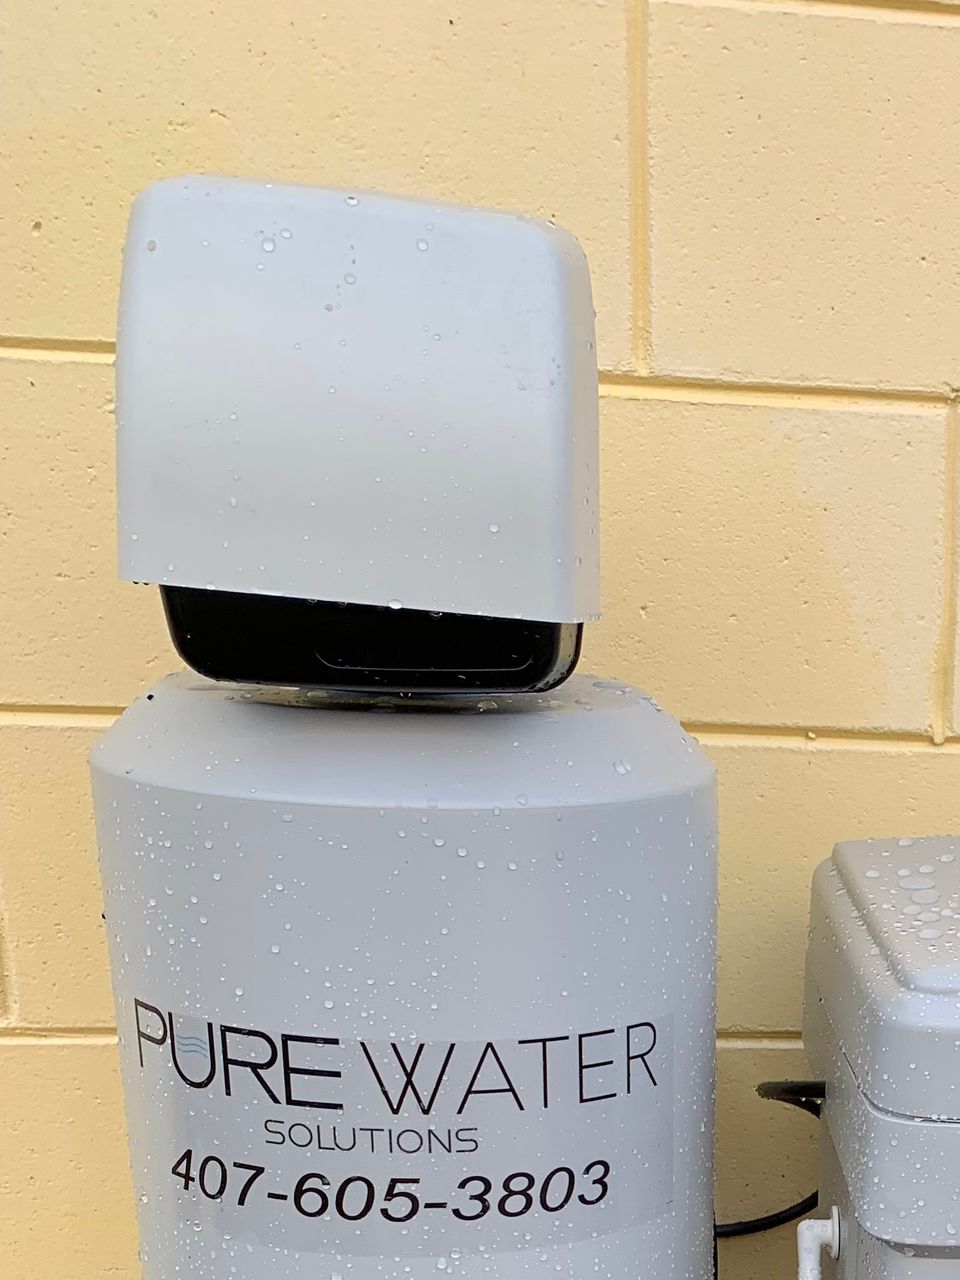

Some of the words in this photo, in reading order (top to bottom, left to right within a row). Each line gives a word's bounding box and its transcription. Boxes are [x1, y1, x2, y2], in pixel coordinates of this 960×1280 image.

[133, 997, 345, 1111] PURE
[360, 1021, 658, 1116] WATER
[263, 1118, 479, 1154] SOLUTIONS
[171, 1148, 611, 1223] 407-605-3803
